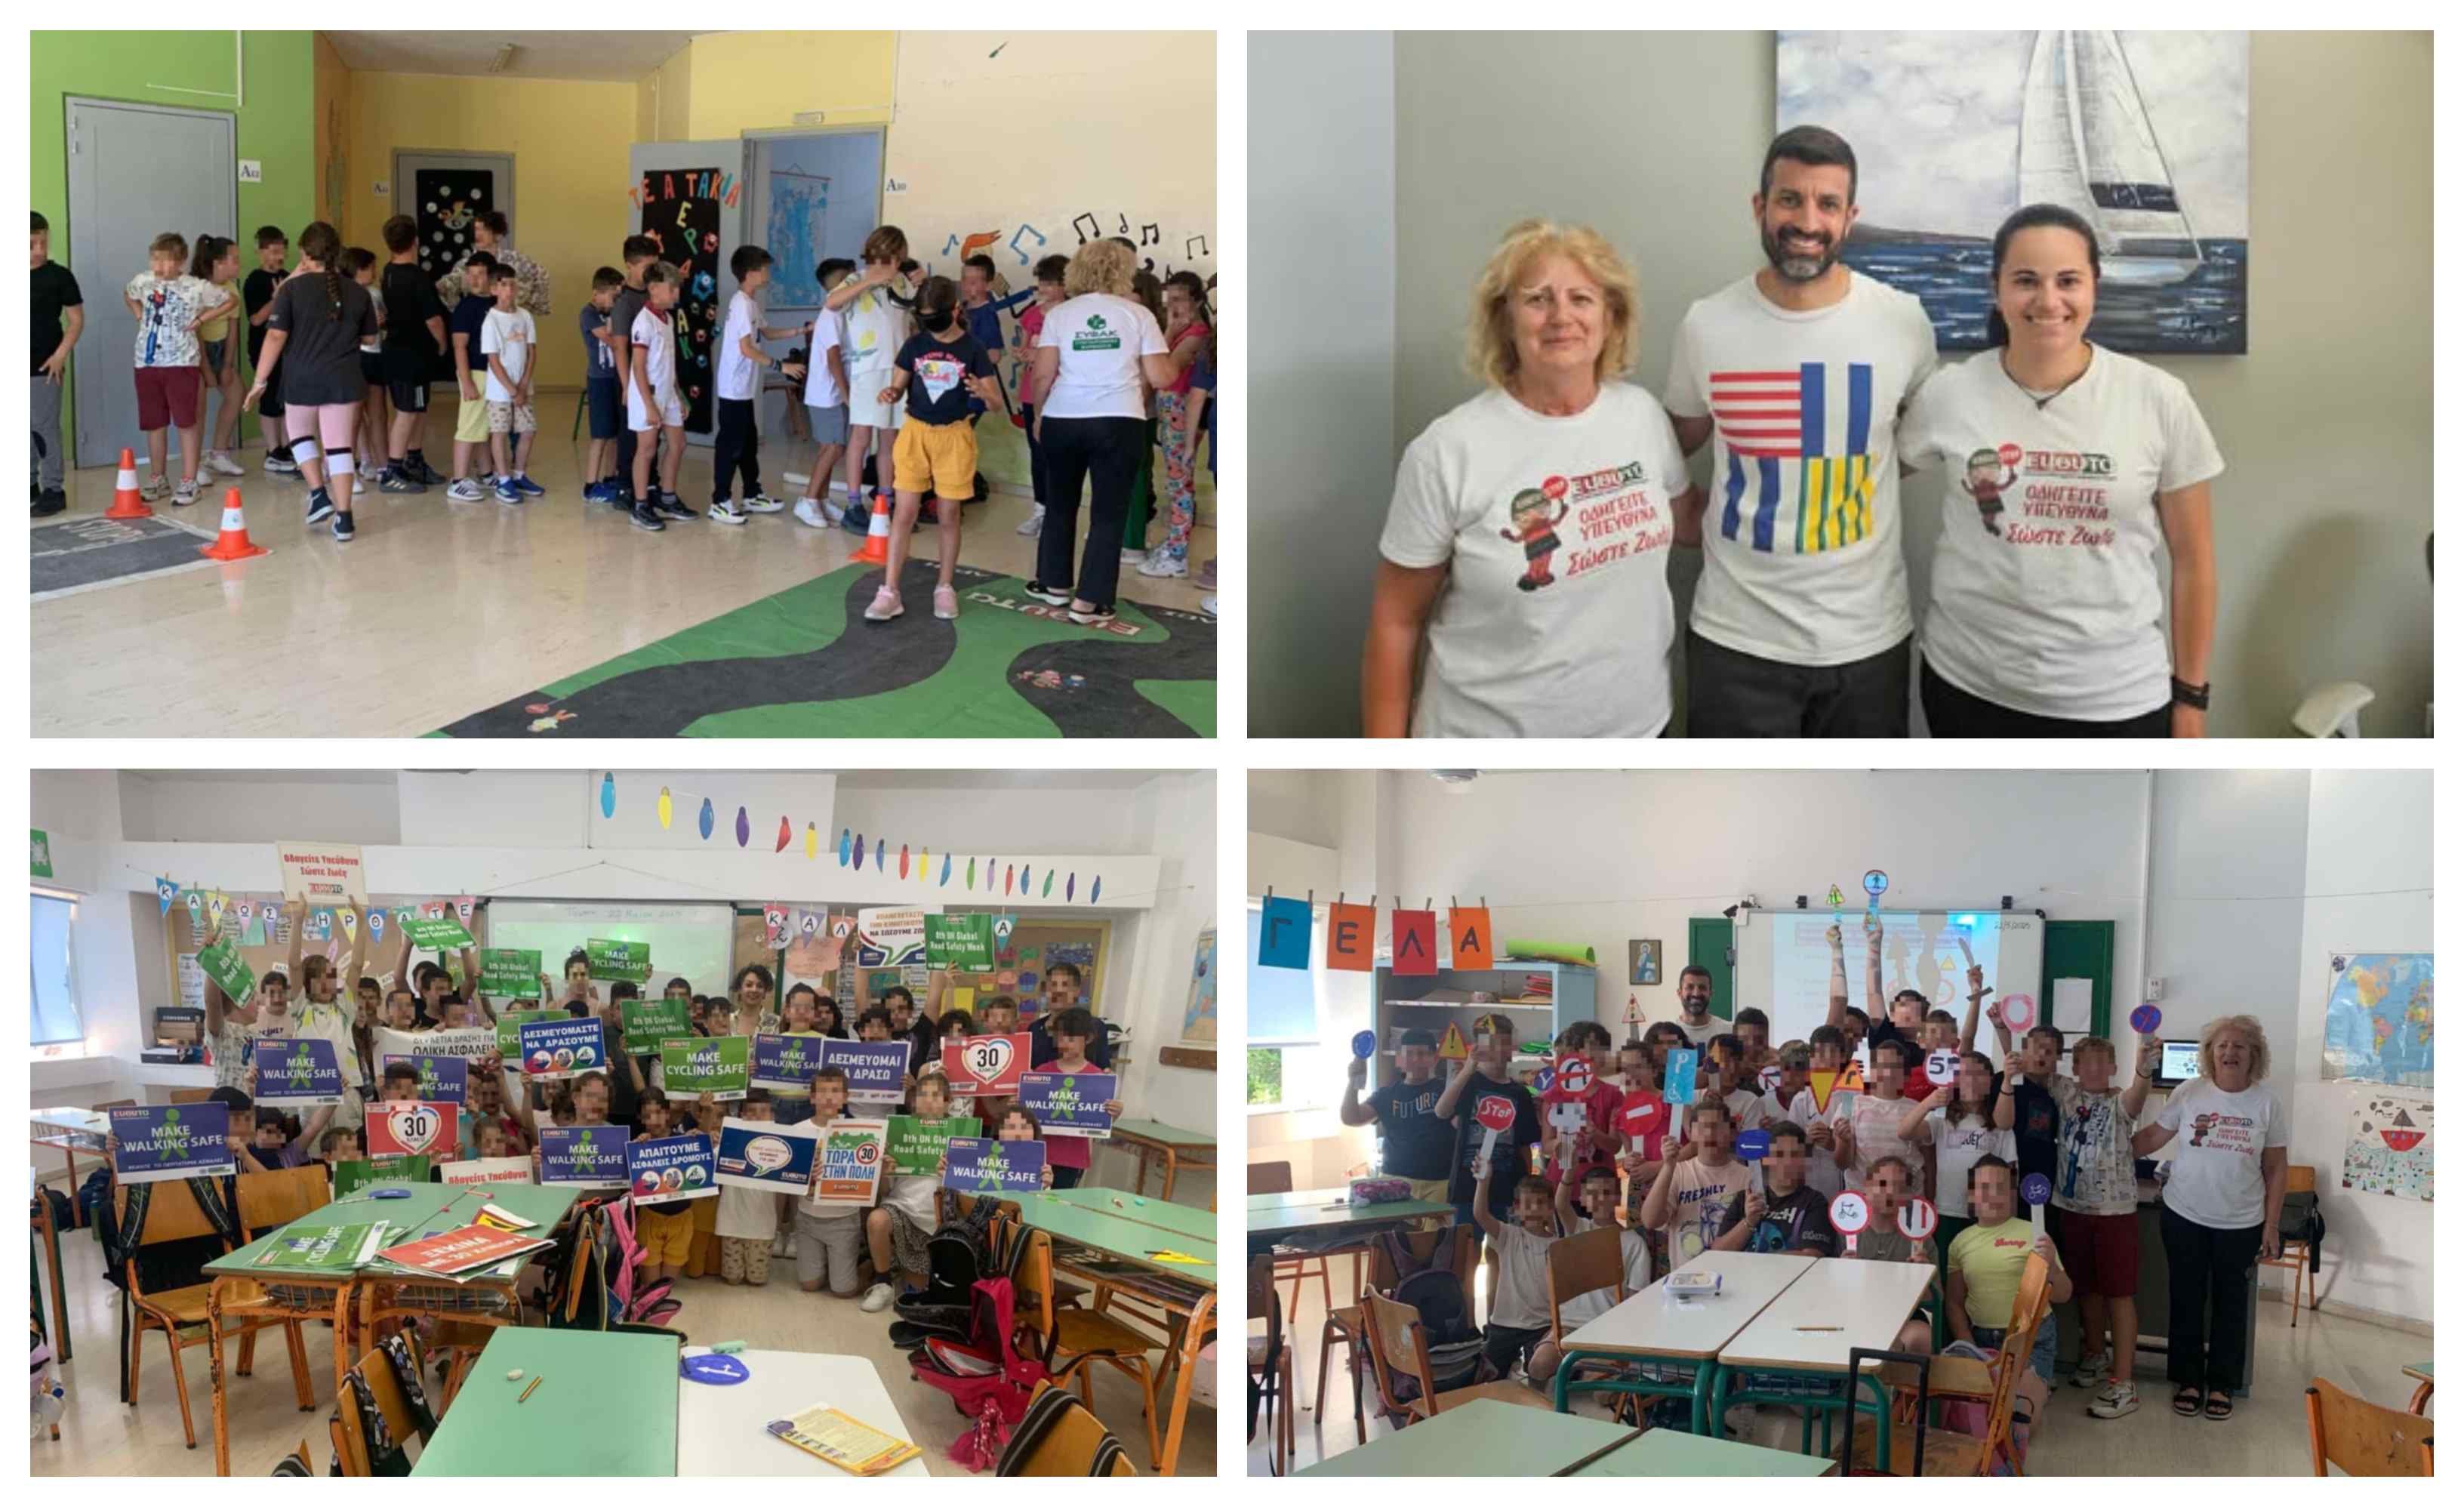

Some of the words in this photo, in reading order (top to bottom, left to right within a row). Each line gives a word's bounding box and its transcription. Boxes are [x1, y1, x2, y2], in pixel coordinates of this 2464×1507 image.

[605, 951, 629, 960] MAKE
[524, 1024, 599, 1039] ΔΕΣΜΕΥΟΜΑΣΤΕ
[545, 1035, 599, 1047] ΔΡΑΣΟΥΜΕ
[686, 1052, 721, 1063] MAKE
[780, 1050, 806, 1059] MAKE
[827, 1054, 901, 1067] ΔΕΣΜΕΥΟΜΑΙ
[977, 1048, 998, 1067] 30
[287, 1057, 316, 1067] MAKE
[760, 1059, 802, 1070] WALKING
[802, 1062, 821, 1070] SAF
[264, 1068, 312, 1079] WALKING
[313, 1068, 337, 1078] SAFE
[420, 1071, 439, 1080] AKE
[666, 1065, 714, 1076] CYCLING
[716, 1064, 745, 1075] SAFE
[854, 1068, 890, 1080] ΔΡΑΣΩ
[437, 1083, 461, 1091] SAFE
[1049, 1091, 1080, 1101] MAKE
[1025, 1100, 1075, 1111] WALKING
[1077, 1102, 1106, 1112] SAFE
[151, 1124, 191, 1137] MAKE
[404, 1116, 427, 1137] 30
[124, 1137, 189, 1152] WALKING
[191, 1135, 223, 1148] SAFE
[903, 1135, 917, 1143] 8th
[919, 1135, 931, 1143] UN
[569, 1144, 599, 1154] MAKE
[639, 1142, 701, 1157] ΑΠΑΙΤΟΥΜΕ
[894, 1145, 914, 1154] Road
[548, 1155, 596, 1166] WALKING
[599, 1155, 624, 1165] SAFE
[631, 1157, 670, 1170] ΑΣΦΑΛΕΙΣ
[672, 1152, 712, 1164] ΔΡΟΜΟΥΣ
[827, 1150, 855, 1164] ΤΩΡΑ
[861, 1148, 873, 1160] 30
[978, 1157, 1010, 1170] MAKE
[822, 1165, 847, 1179] ΣΤΗΝ
[849, 1165, 876, 1179] ΠΟΛΗ
[953, 1166, 1005, 1181] WALKING
[1006, 1171, 1036, 1184] SAFE
[1678, 1184, 1726, 1204] FRESHLY
